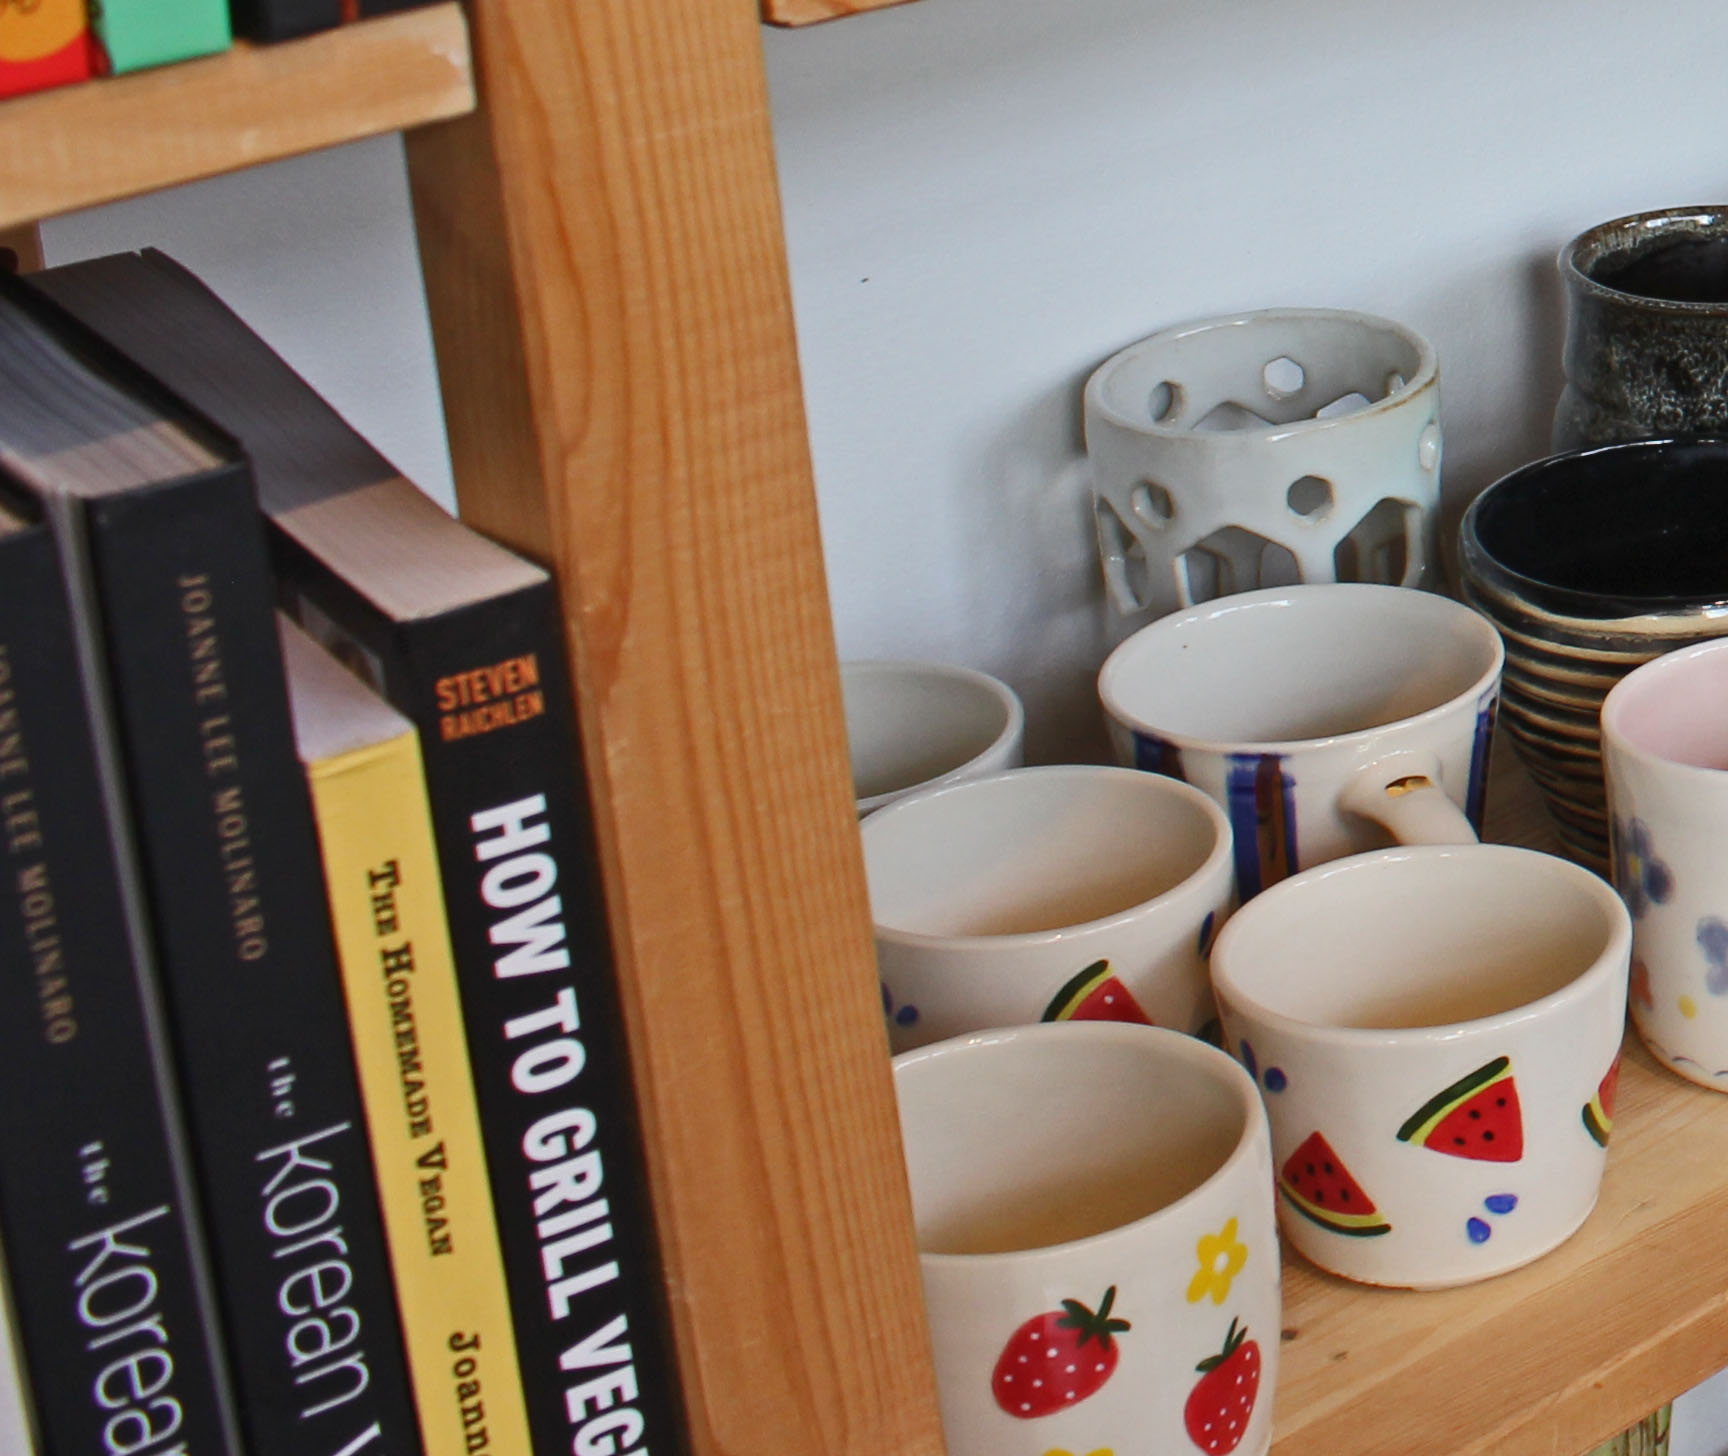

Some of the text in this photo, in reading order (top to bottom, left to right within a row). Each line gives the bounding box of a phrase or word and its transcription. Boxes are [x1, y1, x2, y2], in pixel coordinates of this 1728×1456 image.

[436, 655, 539, 711] STEVEN
[442, 693, 545, 742] RAICHLEN
[471, 793, 620, 1321] HOW TO GRILL
